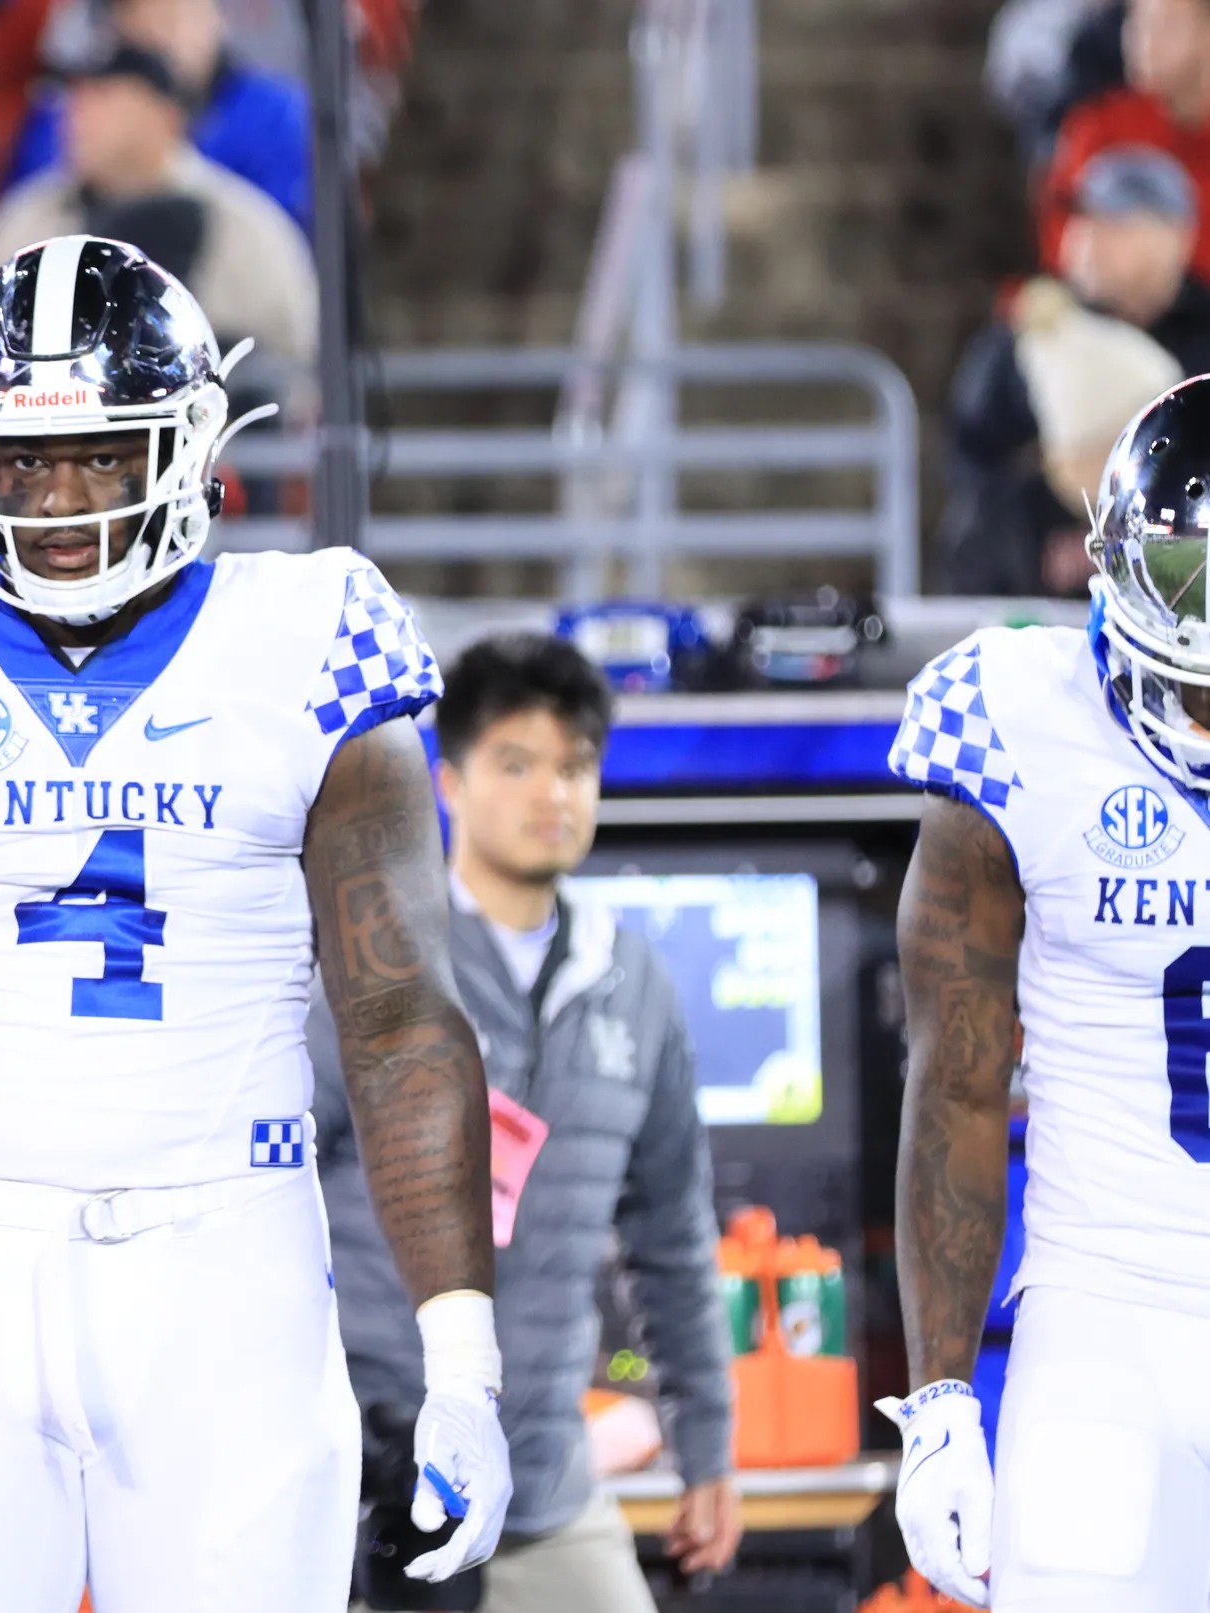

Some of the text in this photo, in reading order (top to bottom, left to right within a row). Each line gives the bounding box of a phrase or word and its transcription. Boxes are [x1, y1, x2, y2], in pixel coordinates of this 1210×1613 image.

[14, 390, 87, 408] Riddell
[47, 691, 99, 734] UK
[1101, 785, 1168, 849] SEC
[1096, 842, 1172, 867] GRADUATE
[1094, 877, 1210, 926] KEN
[14, 828, 168, 1022] 4
